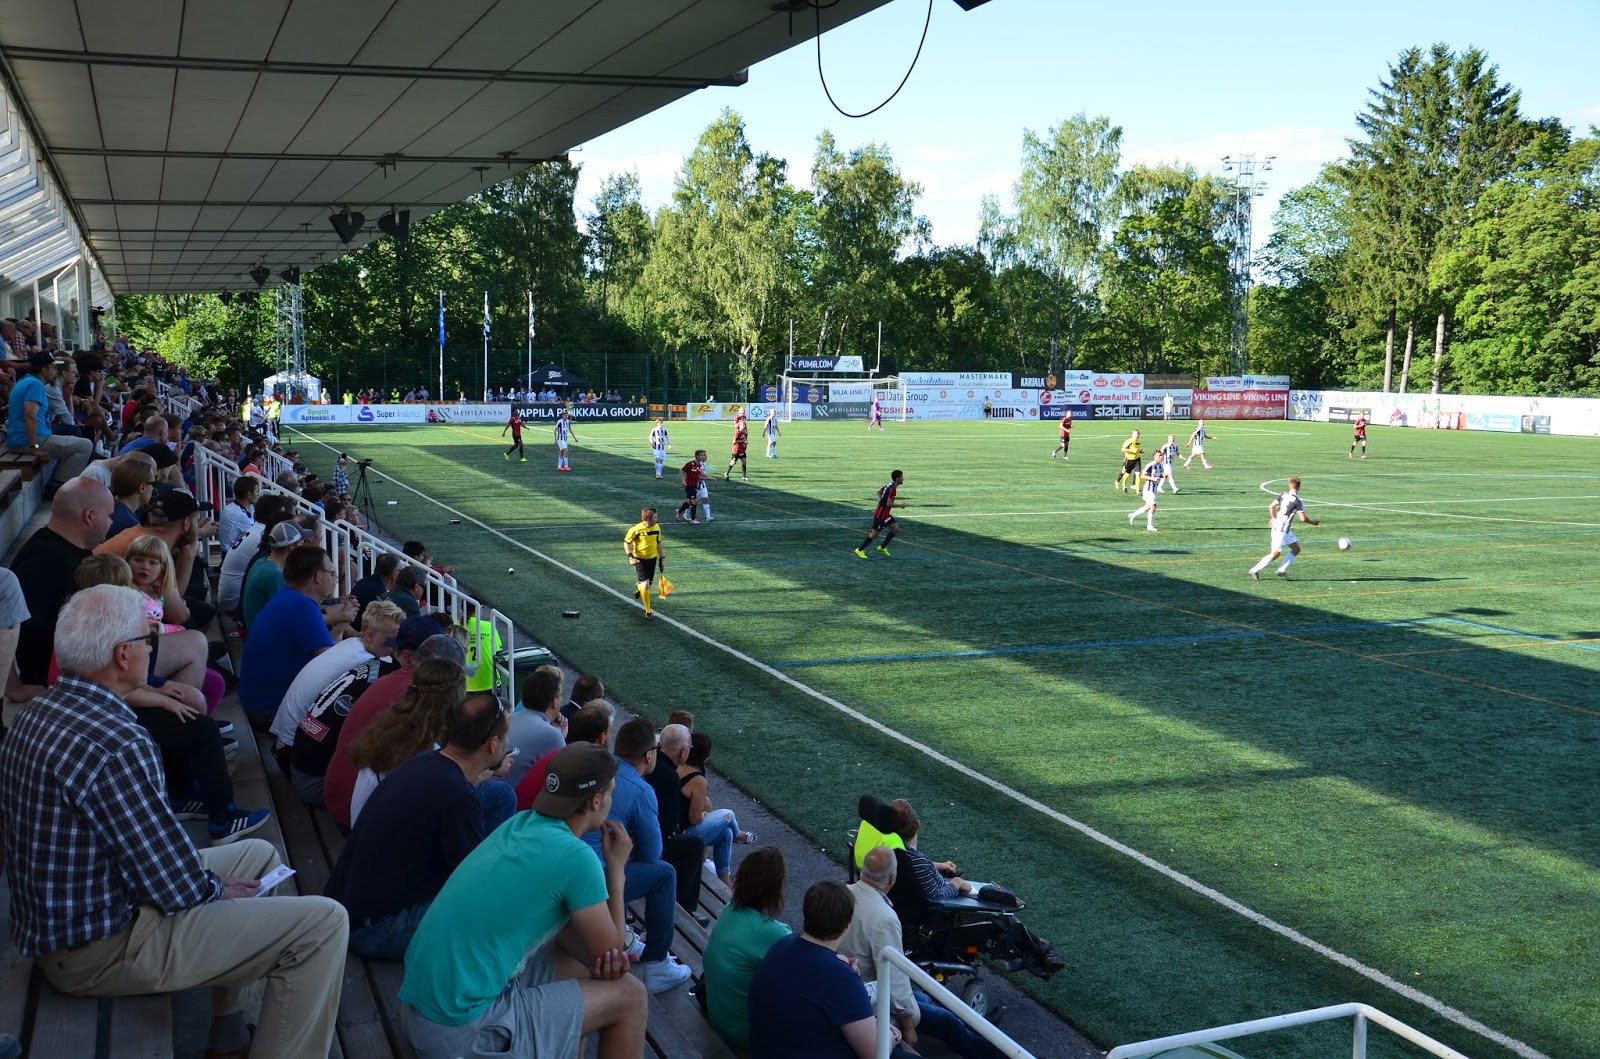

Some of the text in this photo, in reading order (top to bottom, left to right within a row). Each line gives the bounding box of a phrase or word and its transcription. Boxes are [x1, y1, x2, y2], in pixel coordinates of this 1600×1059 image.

[798, 359, 833, 369] PUMA.COM
[1020, 377, 1045, 387] KARJALA
[1193, 393, 1241, 401] VIKING LINE
[1242, 393, 1288, 402] VIKING LINE
[1291, 393, 1325, 403] GANT
[376, 409, 421, 419] Super Analytics
[453, 409, 504, 417] MEHILÄINEN
[610, 407, 645, 417] GROUP
[1094, 405, 1142, 417] stadium
[300, 413, 336, 422] Apteekki.fi
